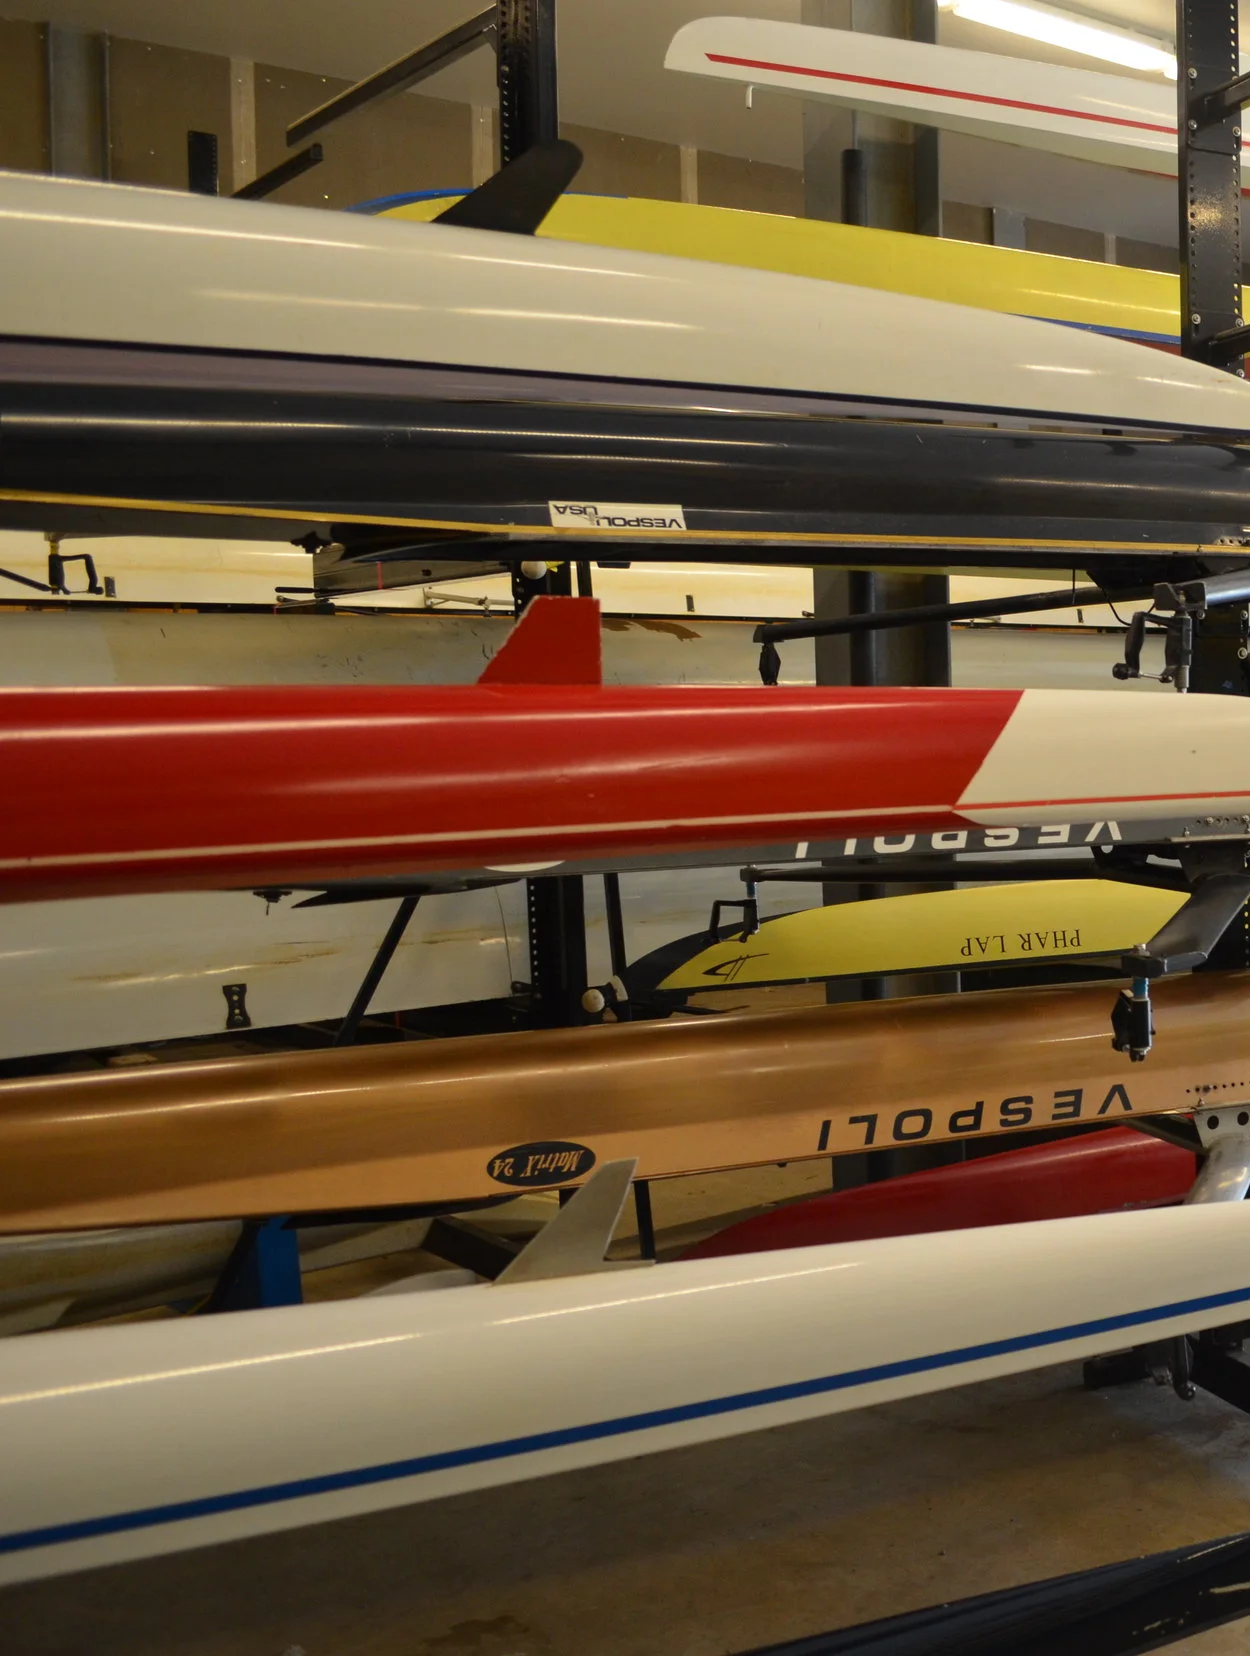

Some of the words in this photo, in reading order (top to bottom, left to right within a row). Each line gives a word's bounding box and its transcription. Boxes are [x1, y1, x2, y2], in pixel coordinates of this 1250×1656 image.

[553, 503, 598, 516] USA
[595, 516, 683, 529] VESPOLI
[960, 934, 1006, 957] LAP
[1018, 929, 1082, 952] PHAR
[817, 1083, 1133, 1151] VESPOLI
[493, 1157, 515, 1178] 24
